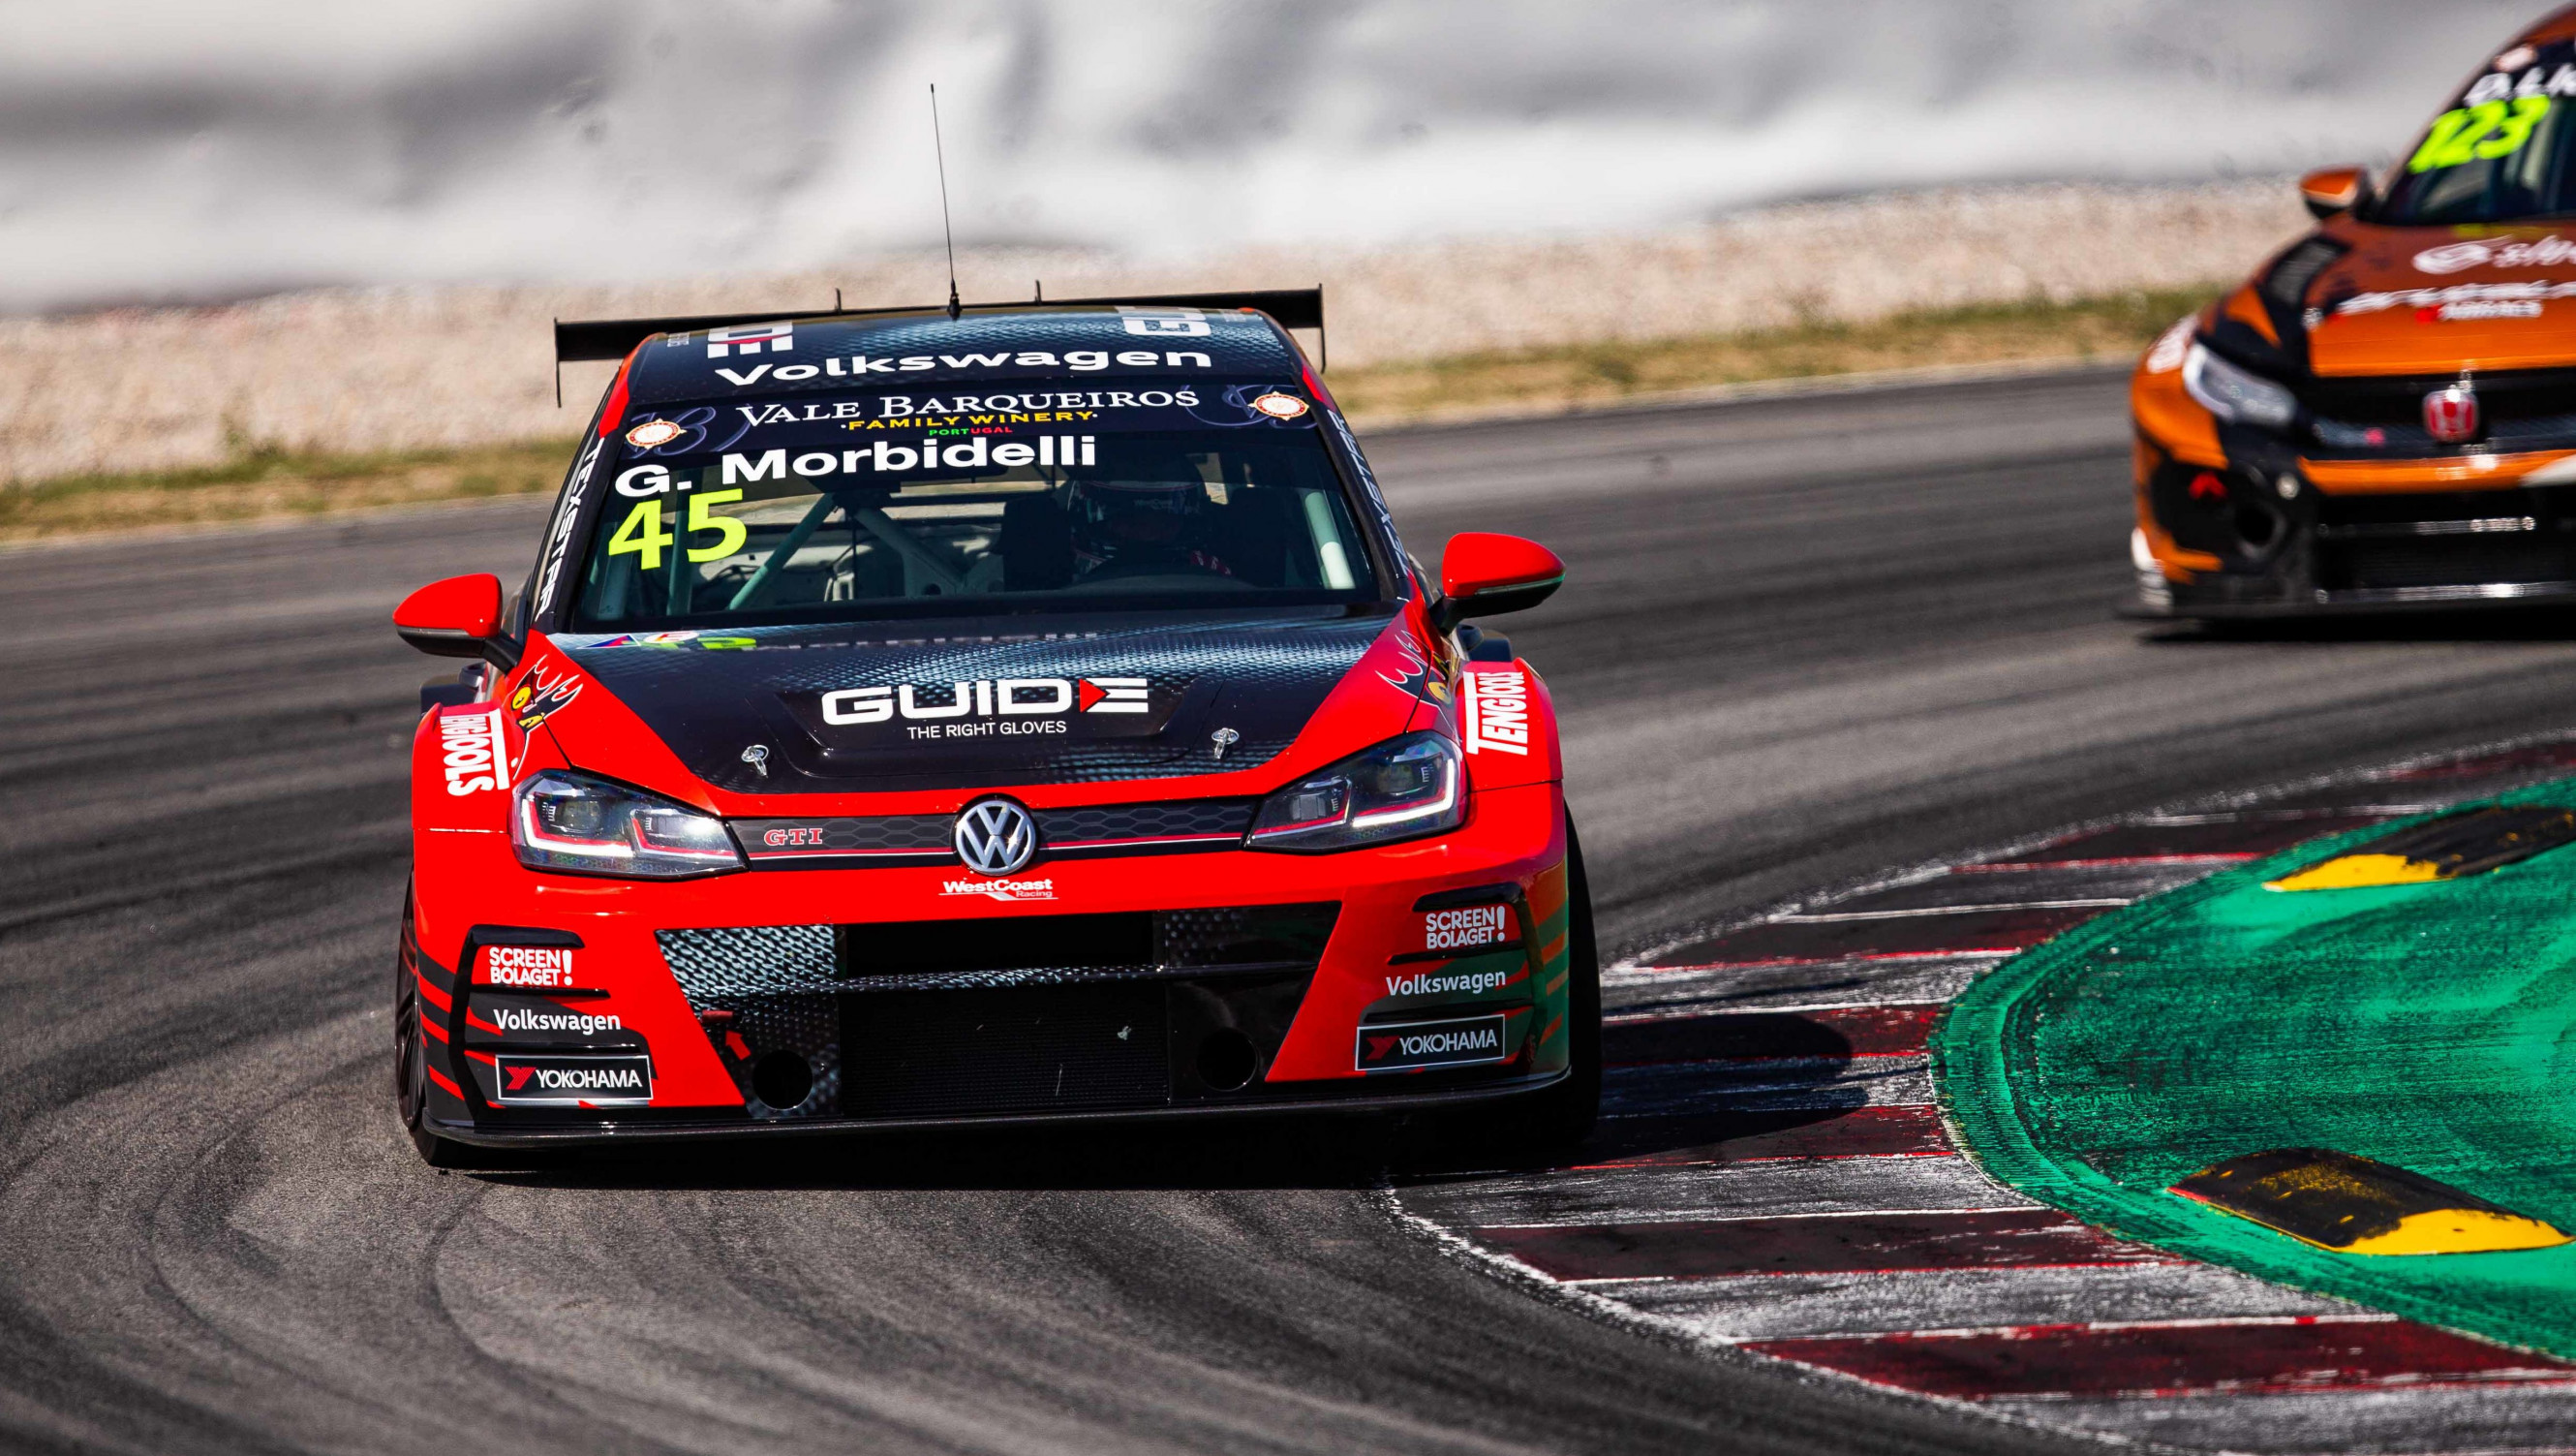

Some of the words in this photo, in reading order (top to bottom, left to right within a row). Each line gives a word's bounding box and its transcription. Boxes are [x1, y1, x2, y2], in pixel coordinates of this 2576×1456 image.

[715, 349, 1211, 387] Volkswagen
[735, 402, 861, 427] VALE
[877, 390, 1200, 418] BARQUEIROS
[848, 416, 961, 430] FAMILY
[968, 411, 1092, 424] WINERY
[928, 426, 1013, 436] PORTUGAL
[615, 465, 691, 497] G.
[721, 435, 1095, 484] Morbidelli
[535, 438, 604, 622] TEXSTAR
[608, 488, 747, 571] 45
[821, 677, 1150, 726] GUIDE
[906, 726, 941, 739] THE
[945, 723, 996, 737] RIGHT
[999, 721, 1067, 735] GLOVES
[763, 827, 823, 846] GTI
[943, 879, 1053, 893] WestCoast
[1386, 971, 1506, 996] Volkswagen
[493, 1008, 621, 1036] Volkswagen
[1399, 1029, 1497, 1055] YOKOHAMA
[536, 1069, 643, 1089] YOKOHAMA
